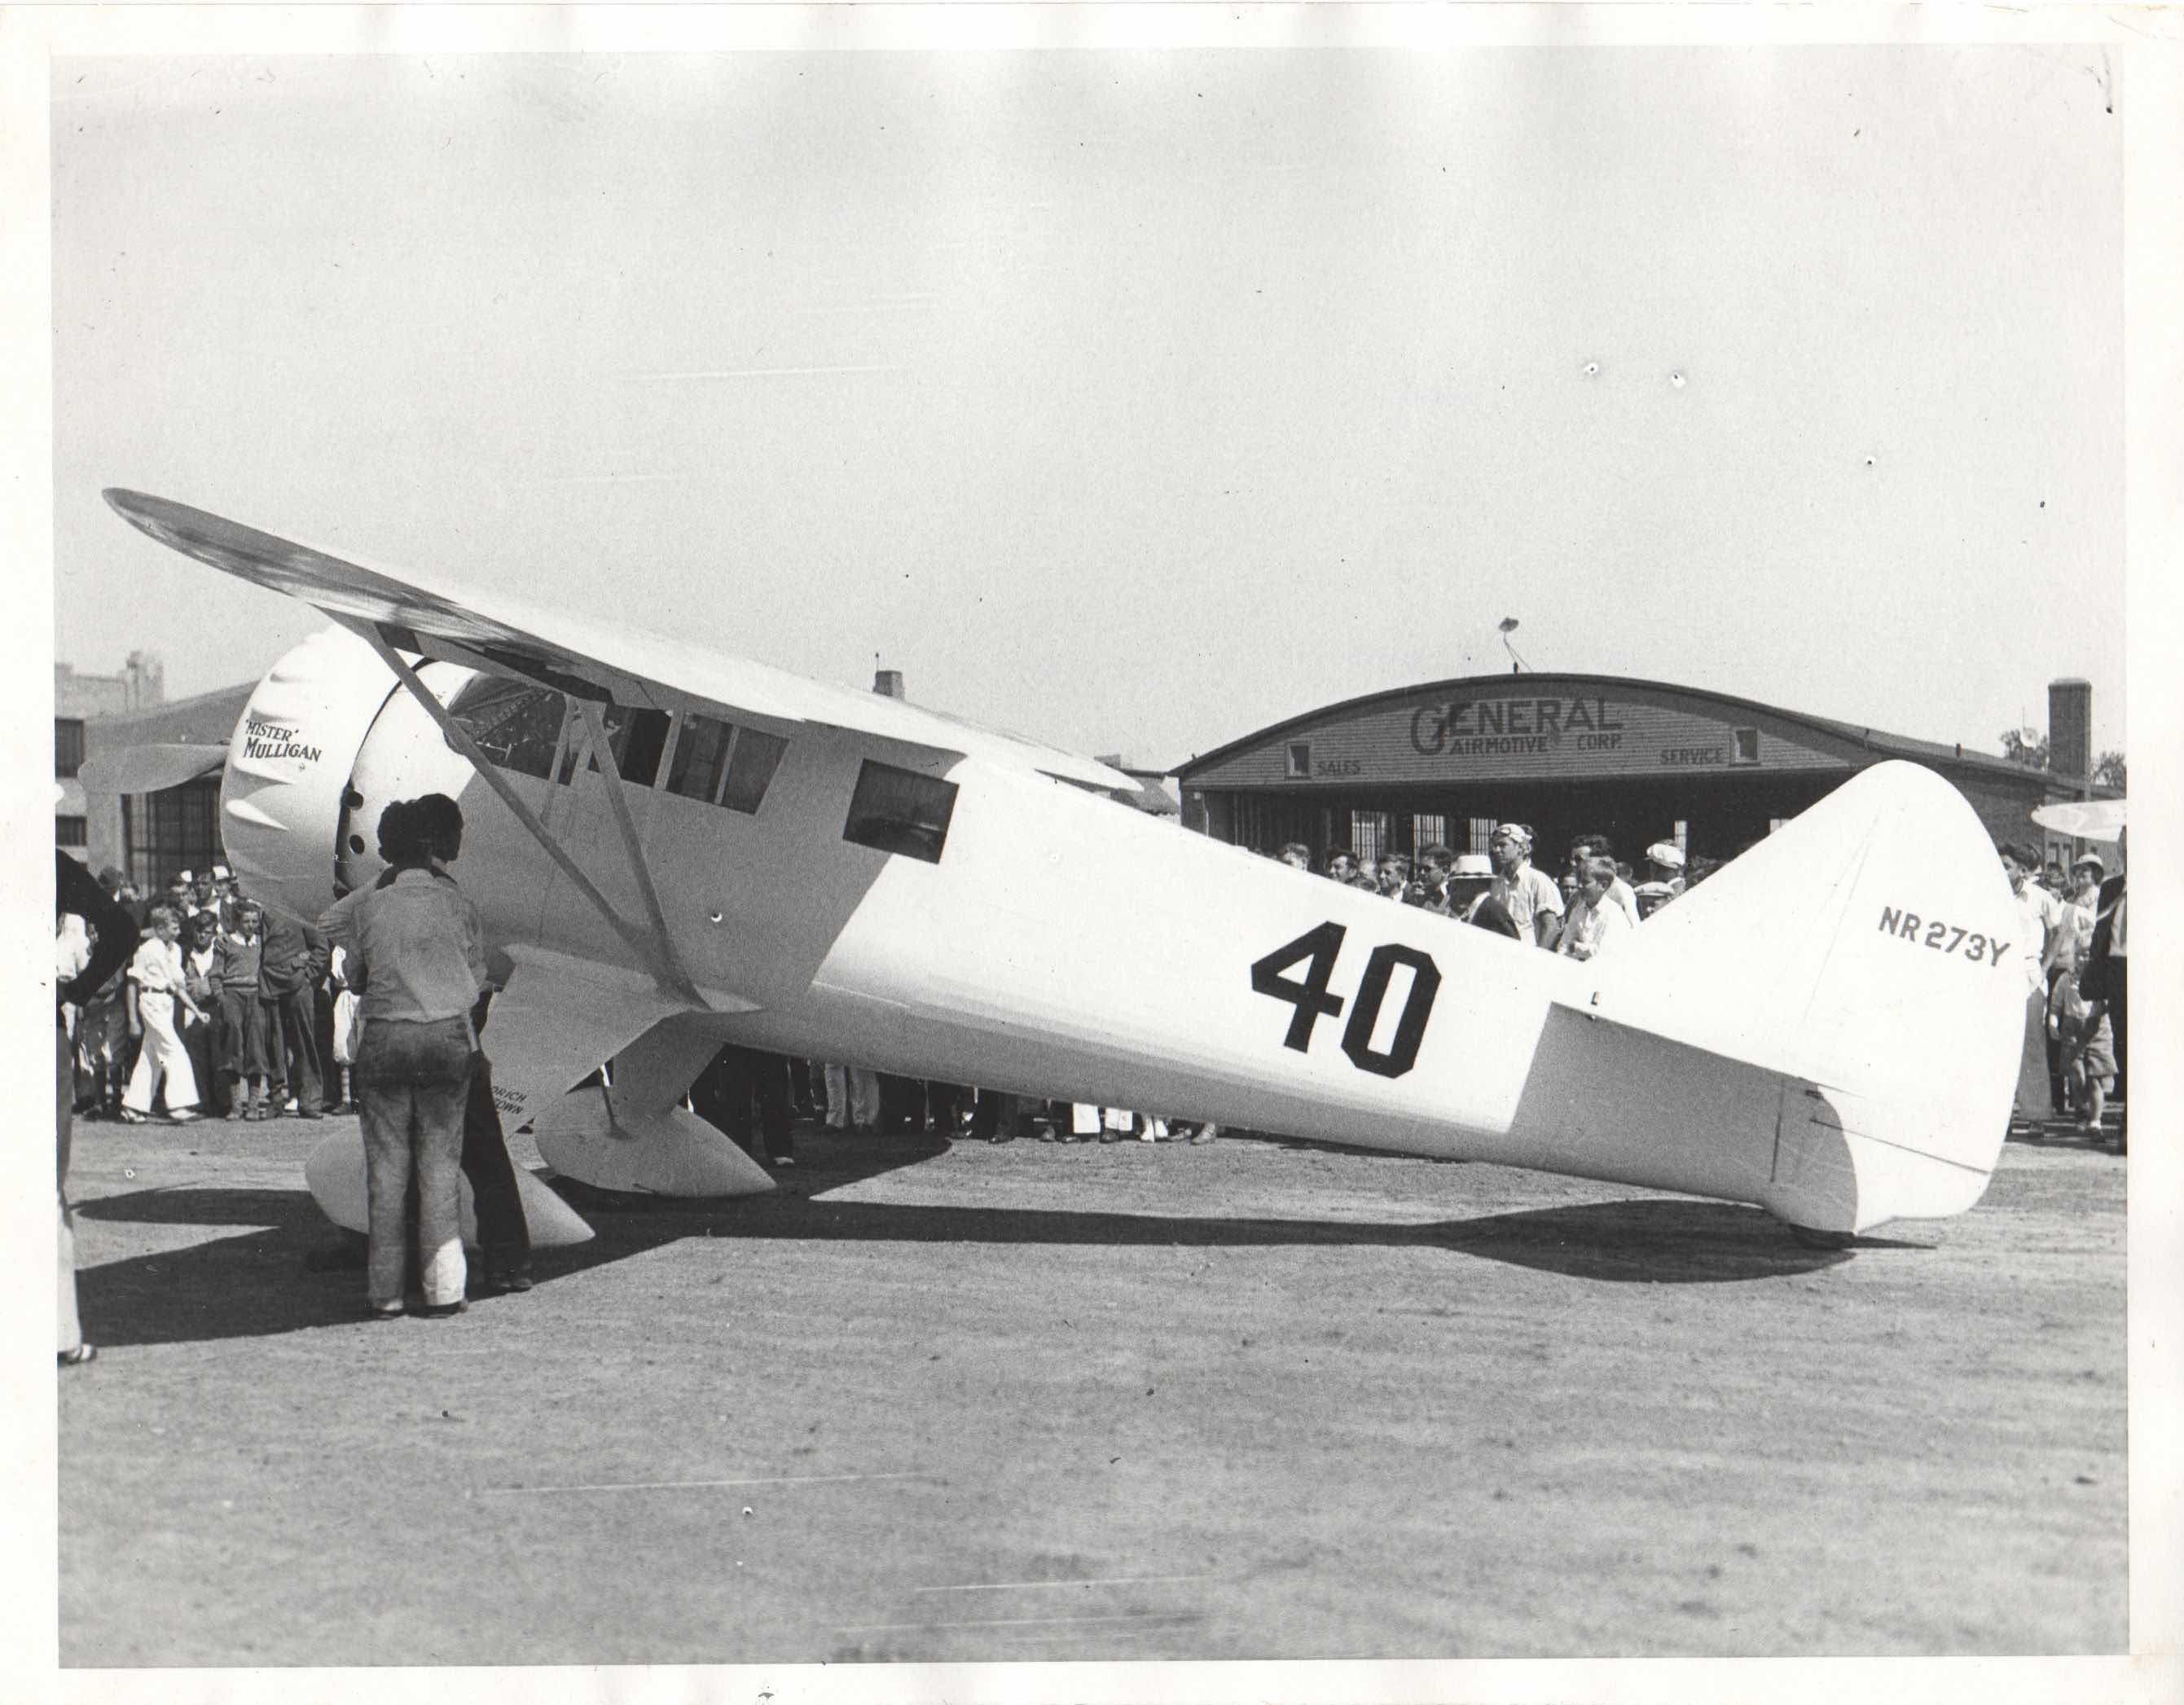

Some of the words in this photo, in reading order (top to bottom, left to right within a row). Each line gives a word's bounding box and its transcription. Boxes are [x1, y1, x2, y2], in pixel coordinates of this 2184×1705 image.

[1411, 696, 1624, 756] GENERAL
[243, 736, 322, 762] MULLIGAN
[1449, 735, 1549, 756] AIRMOTIVE
[1659, 746, 1725, 765] SERVICE
[1316, 759, 1362, 776] SALES
[1250, 921, 1443, 1079] 40
